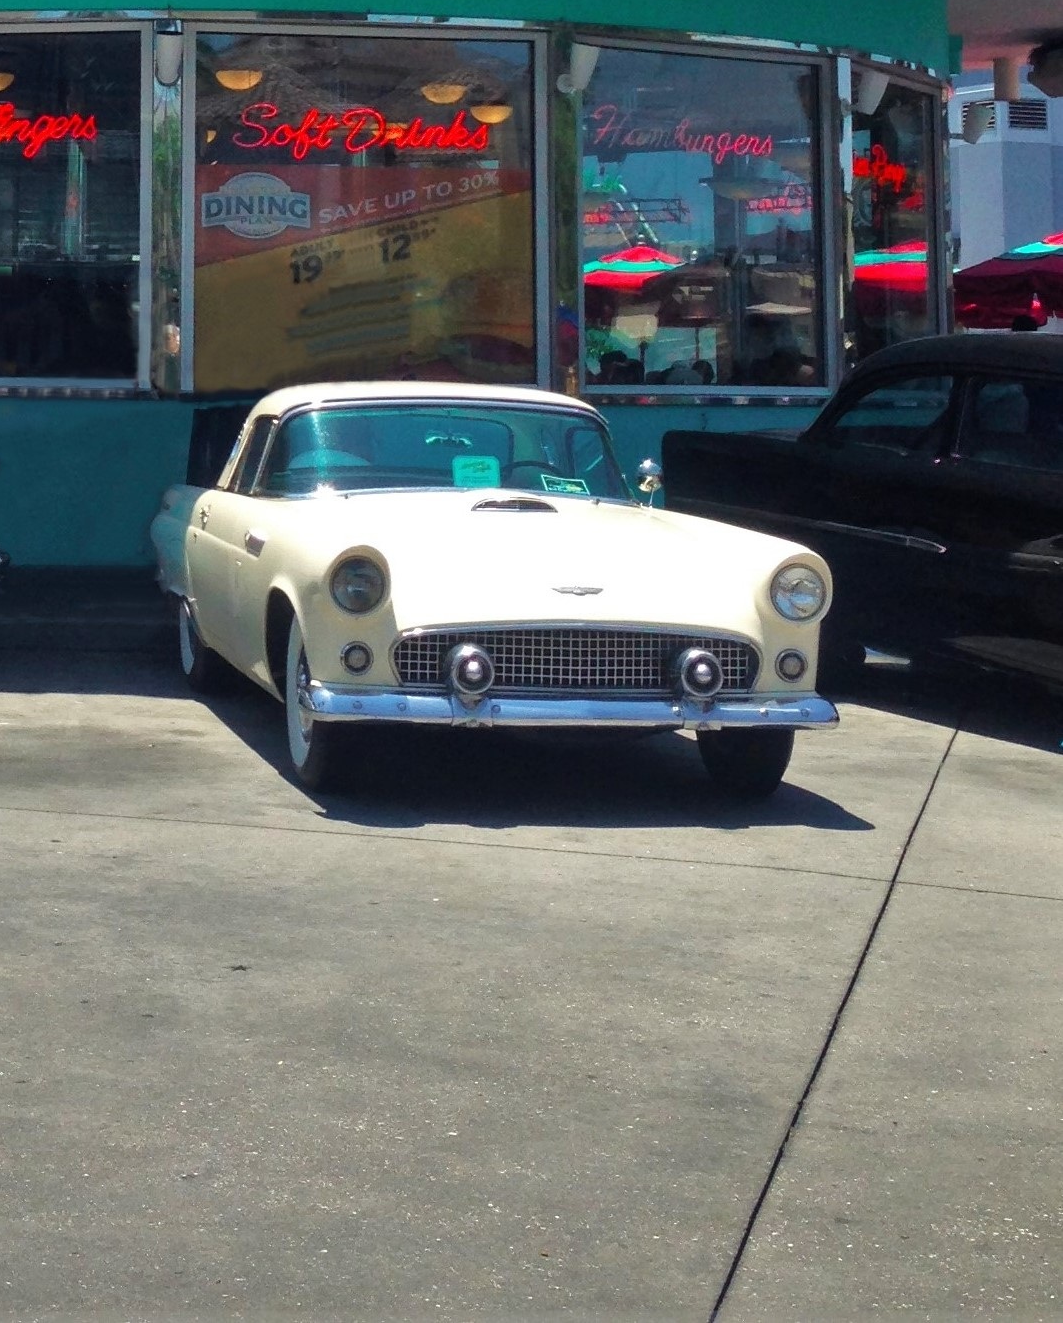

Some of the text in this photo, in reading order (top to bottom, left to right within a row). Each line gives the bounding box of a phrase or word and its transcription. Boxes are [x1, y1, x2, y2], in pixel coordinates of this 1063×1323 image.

[232, 102, 490, 160] Soft Drinks
[592, 104, 774, 165] Hamburgers
[204, 195, 308, 219] DINING
[318, 198, 378, 224] SAVE
[385, 189, 417, 209] UP
[423, 181, 453, 201] TO
[458, 170, 500, 193] 30%
